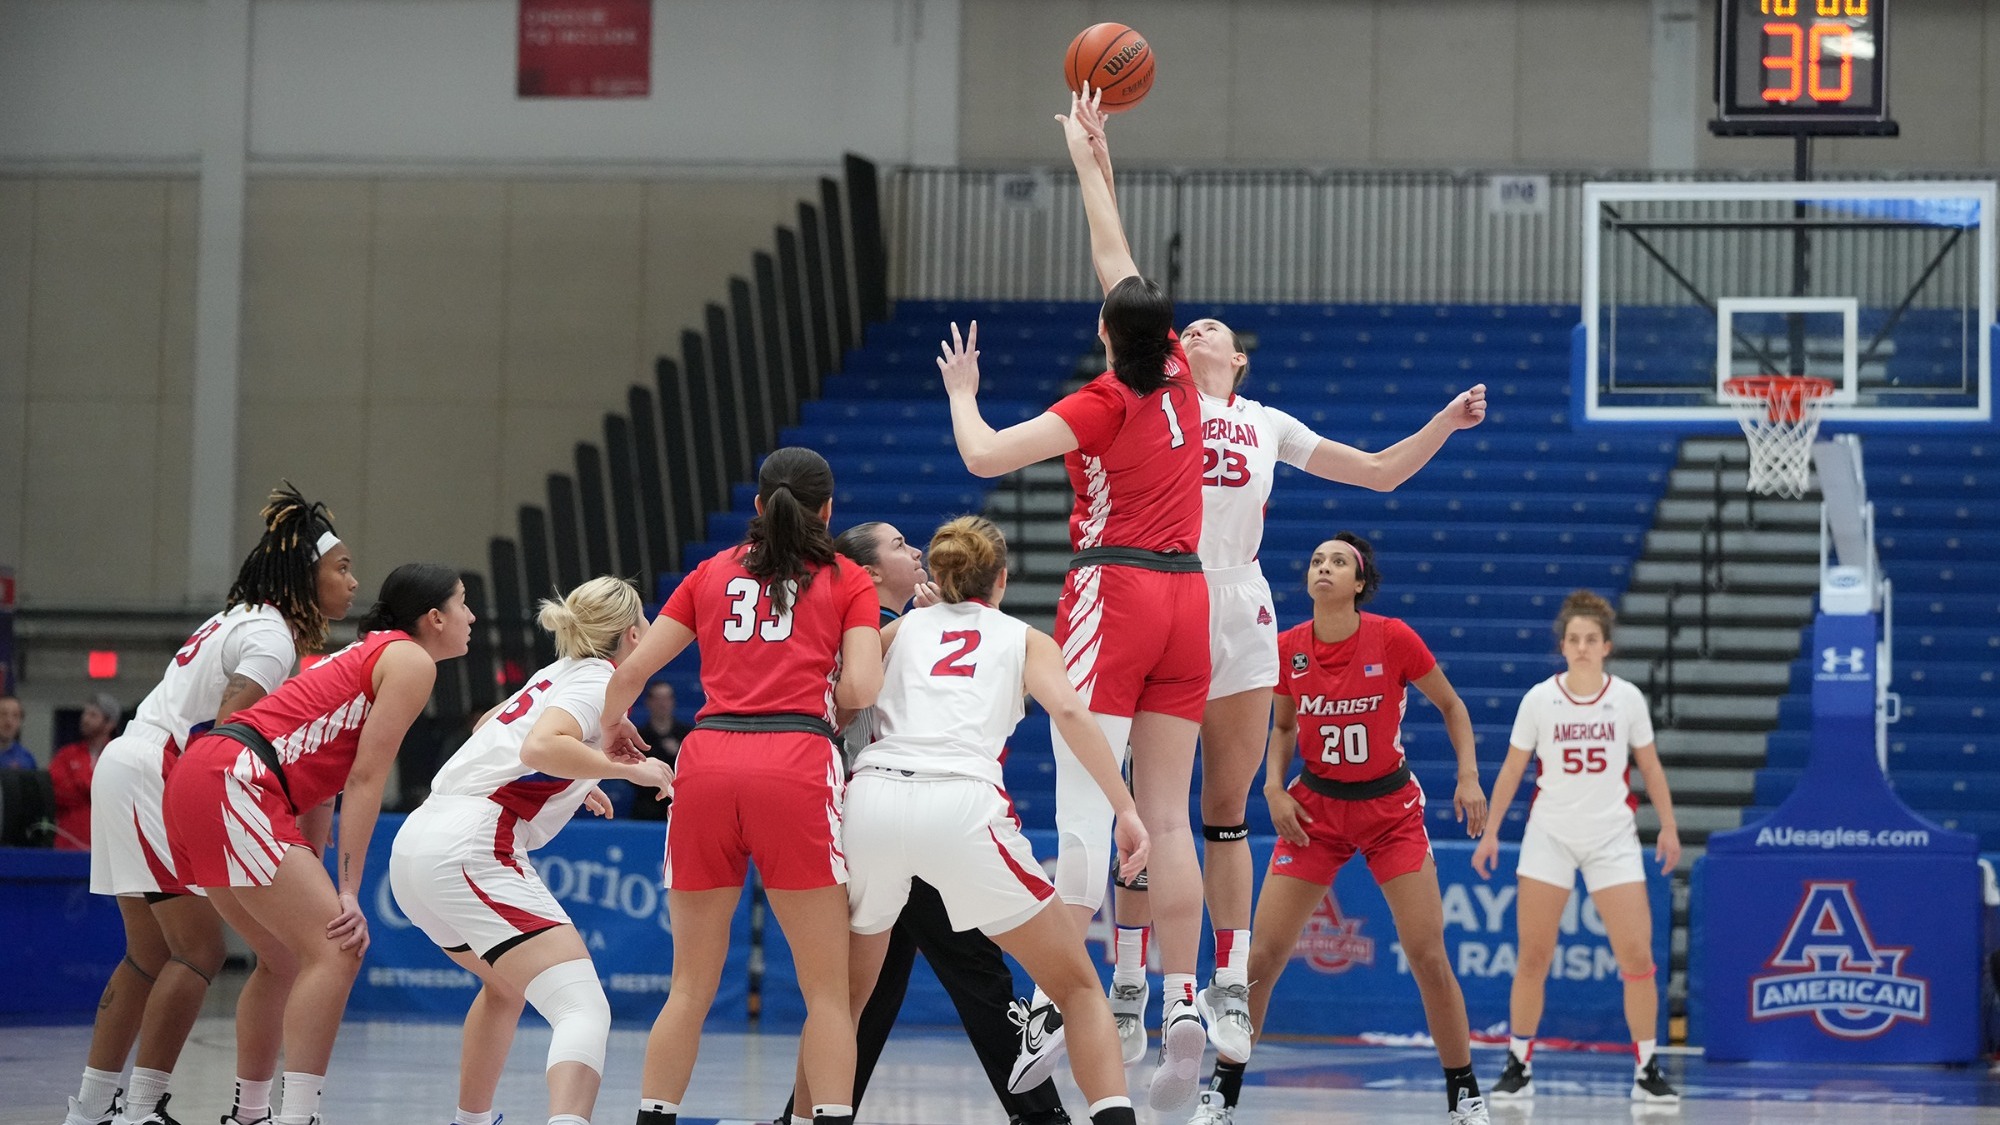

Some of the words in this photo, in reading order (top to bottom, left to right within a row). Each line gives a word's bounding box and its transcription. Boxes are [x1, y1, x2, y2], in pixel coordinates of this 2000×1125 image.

[1761, 22, 1853, 102] 30
[1160, 390, 1185, 449] 1
[1202, 447, 1251, 487] 23
[723, 576, 798, 642] 33
[930, 629, 981, 678] 2
[1297, 694, 1383, 716] MARIST
[1319, 723, 1369, 765] 20
[1553, 722, 1615, 743] AMERICAN
[1562, 747, 1607, 774] 55
[1755, 826, 1930, 849] AUeagles.com
[1458, 940, 1621, 981] RAISM
[1762, 978, 1918, 1009] AMERICAN
